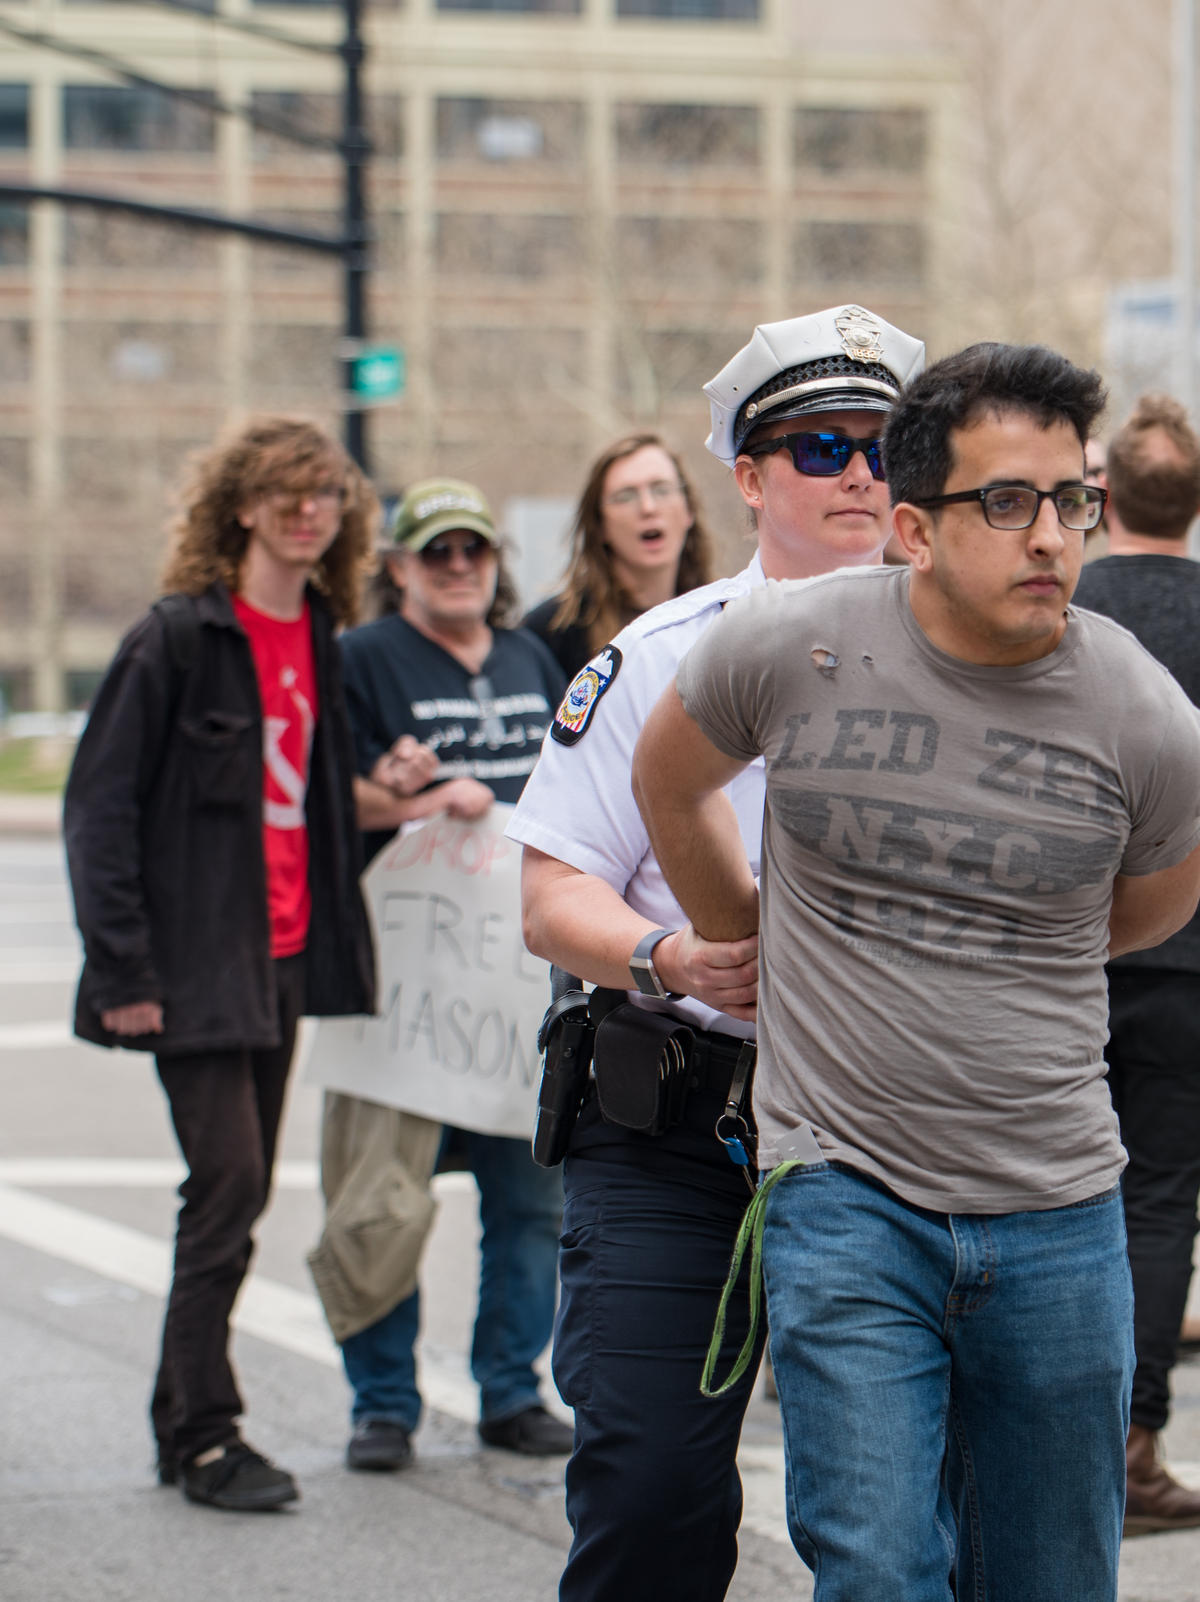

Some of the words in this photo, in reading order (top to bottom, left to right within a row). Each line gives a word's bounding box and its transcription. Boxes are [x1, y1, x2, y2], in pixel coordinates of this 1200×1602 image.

[768, 708, 941, 776] LED
[819, 797, 1054, 892] N.Y.C.
[831, 886, 1020, 956] 1971
